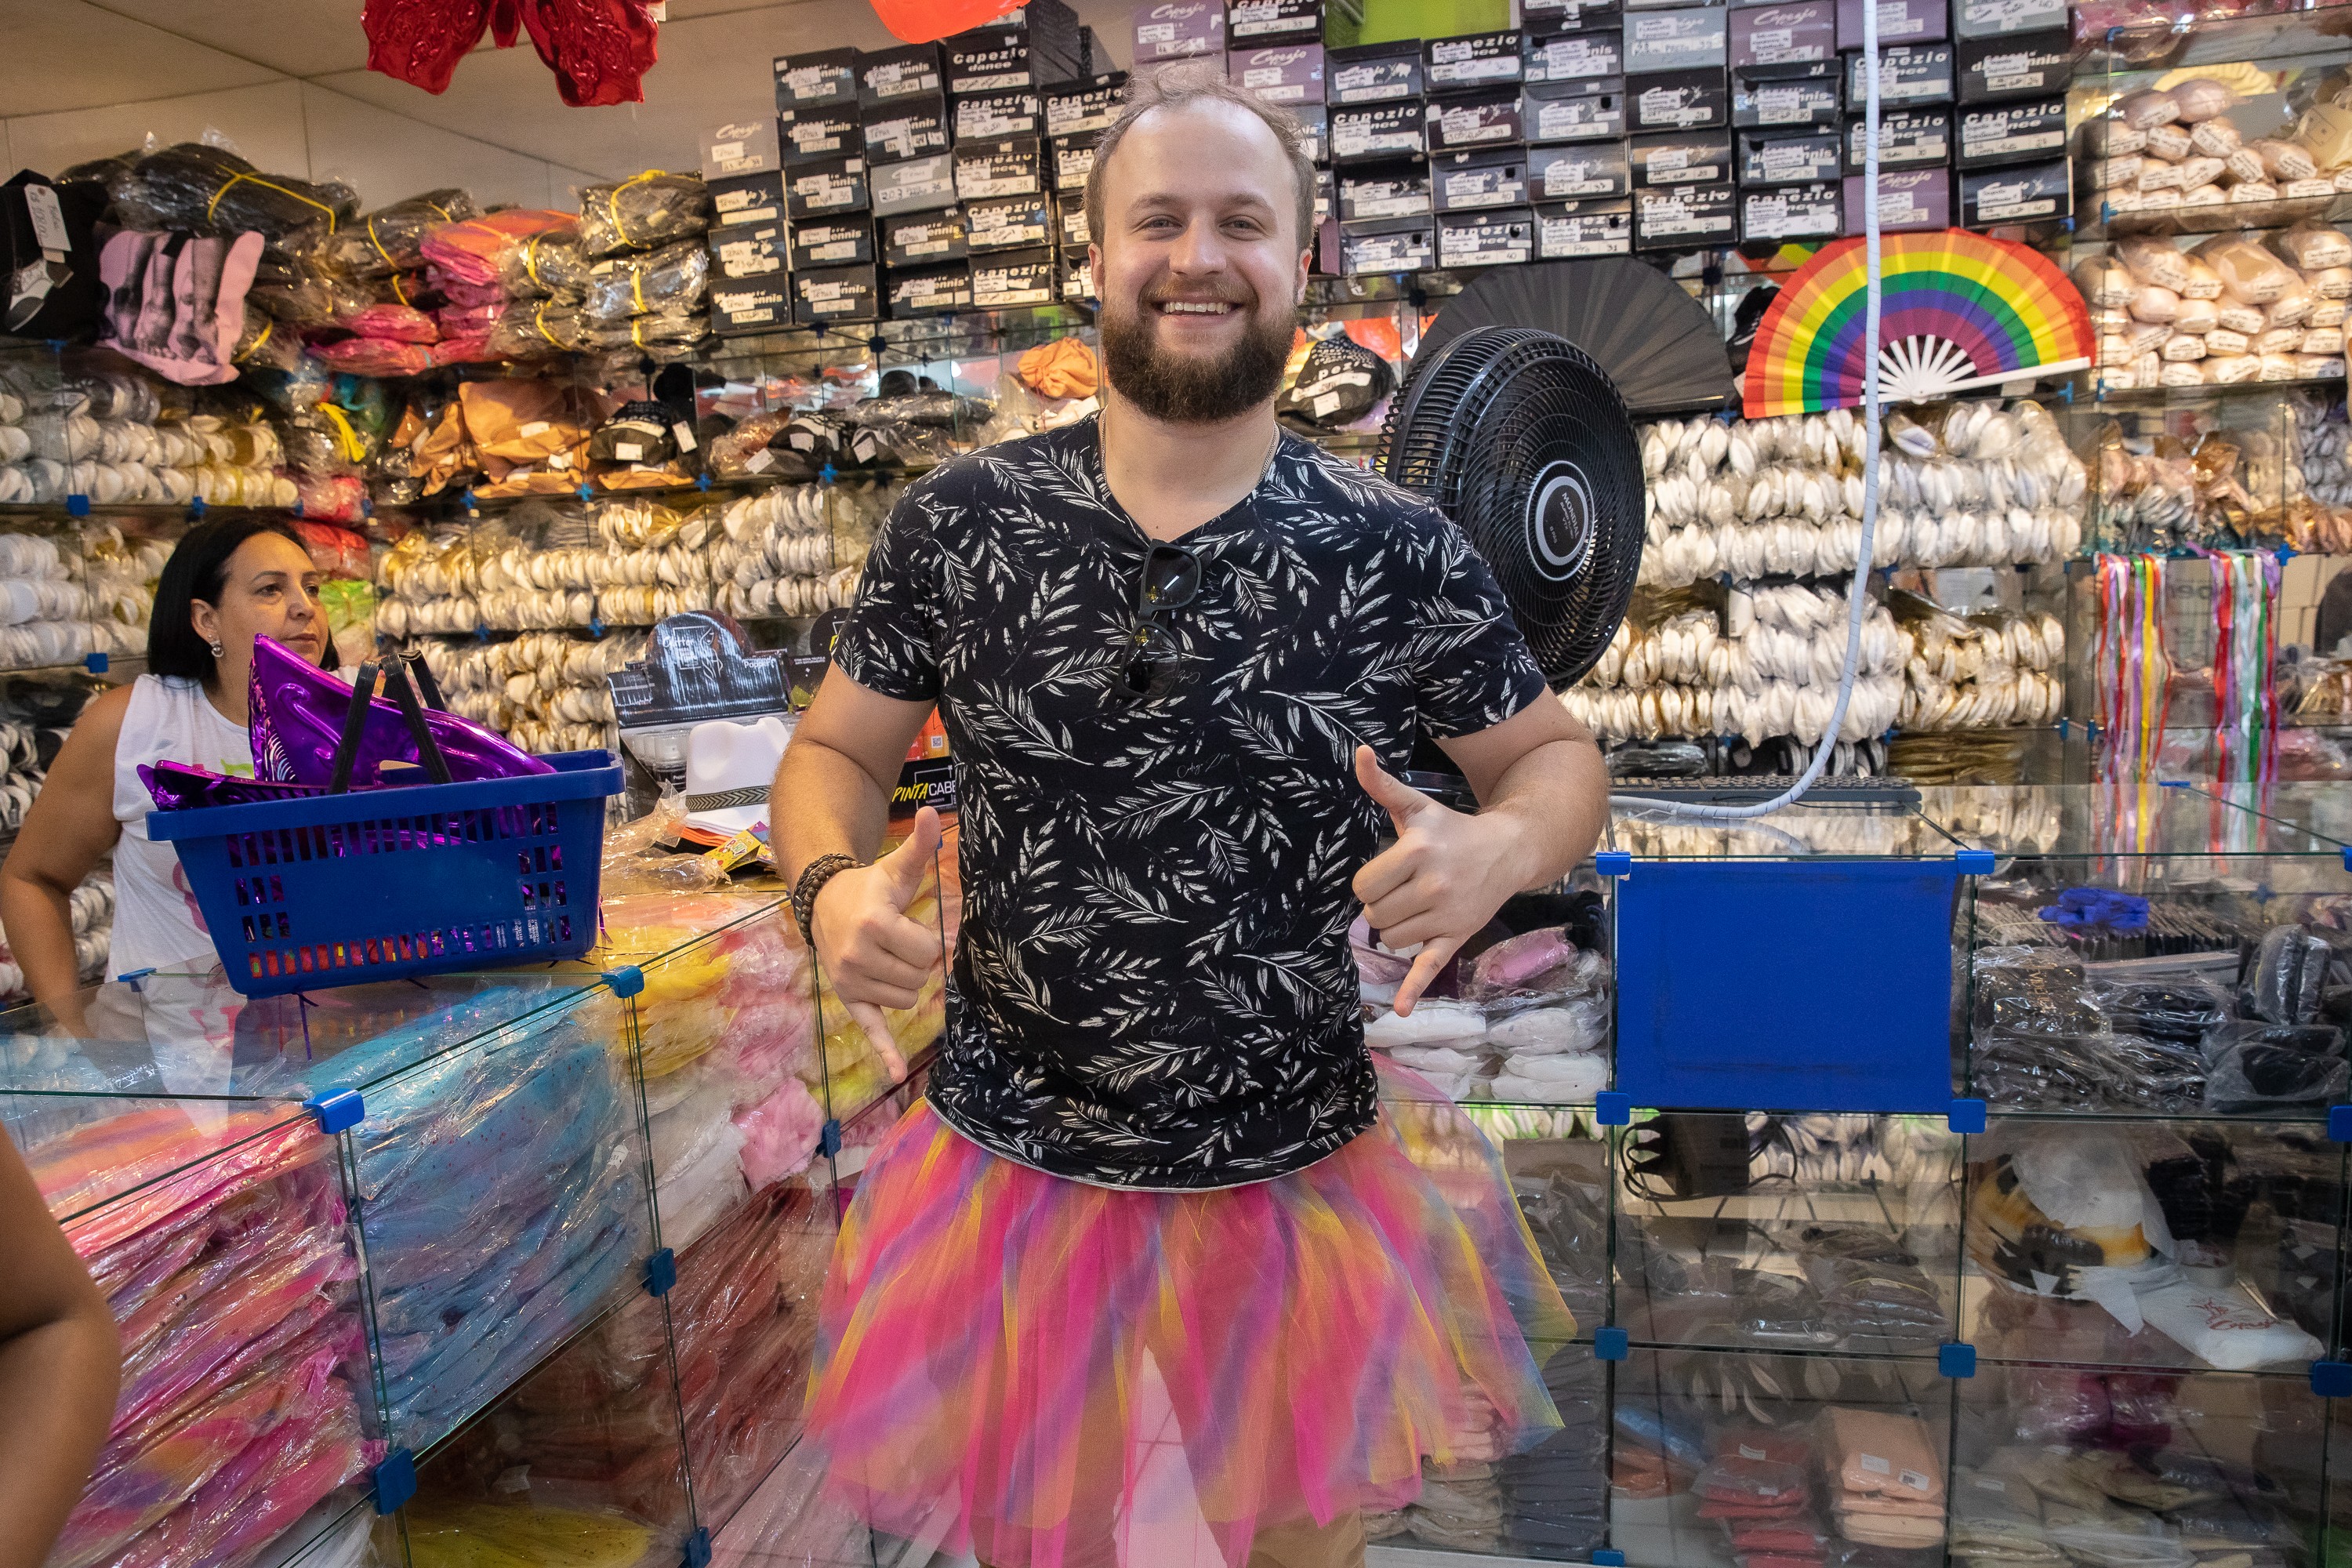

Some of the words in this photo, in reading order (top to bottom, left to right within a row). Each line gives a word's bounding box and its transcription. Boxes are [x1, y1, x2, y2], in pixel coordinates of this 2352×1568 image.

[953, 48, 1029, 64] Capezio
[1855, 51, 1947, 69] Cpezio
[968, 60, 1013, 72] dance
[1853, 116, 1944, 132] Cpezio
[1562, 492, 1580, 539] MONDIAL
